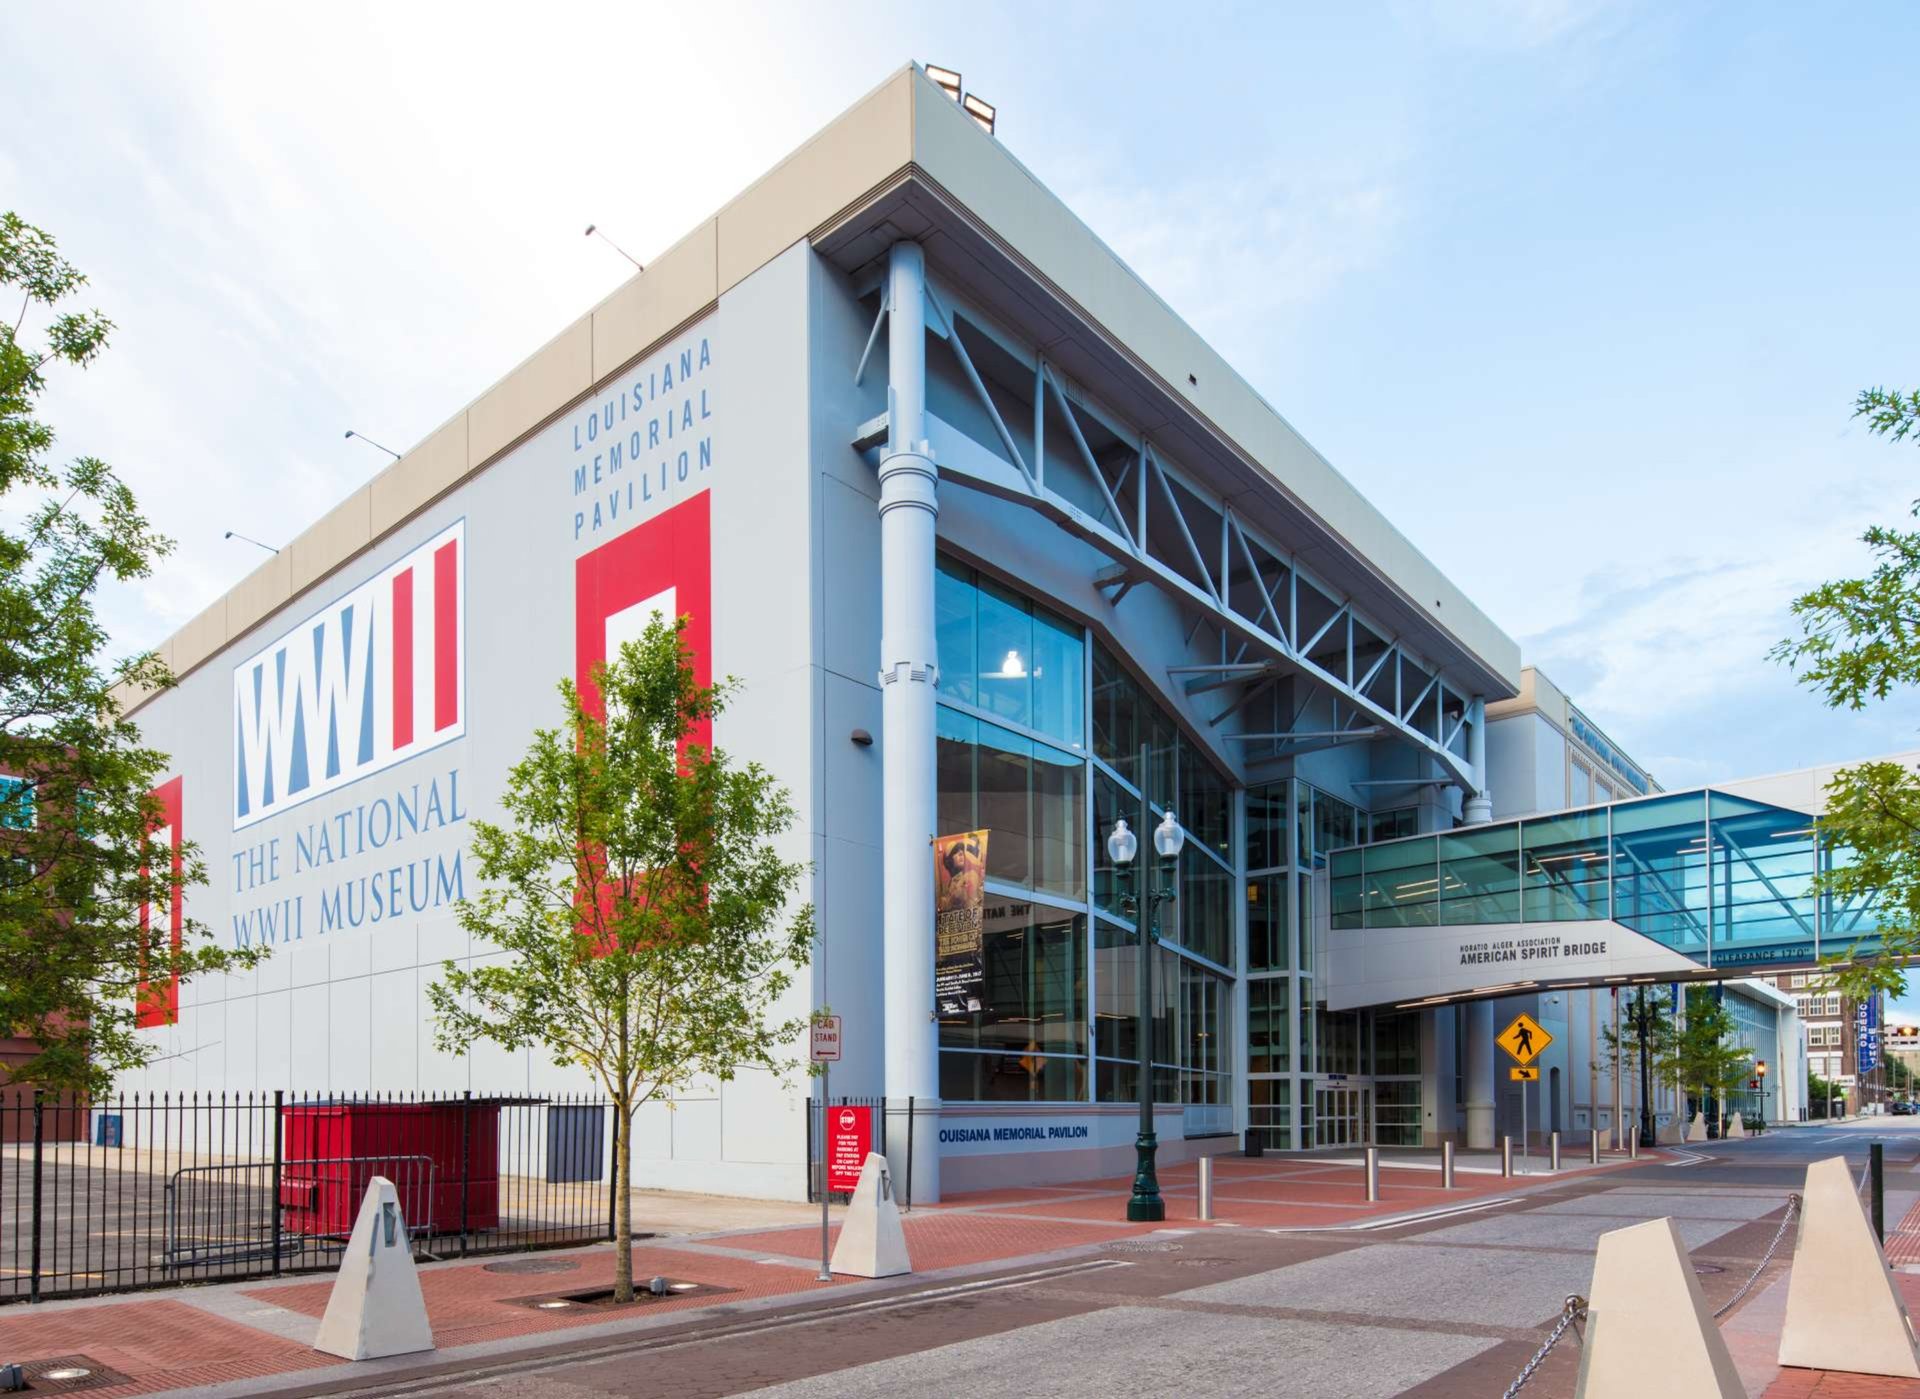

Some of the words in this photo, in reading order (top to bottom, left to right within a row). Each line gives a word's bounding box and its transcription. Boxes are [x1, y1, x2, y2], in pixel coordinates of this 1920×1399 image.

[574, 338, 711, 452] LOUISIANA
[574, 389, 711, 496] MEMORIAL
[575, 437, 711, 540] PAVILION
[237, 538, 457, 818] WWII
[232, 838, 279, 893] THE
[295, 769, 466, 873] NATIONAL
[232, 896, 303, 950] WWII
[319, 848, 465, 934] MUSEUM
[1460, 943, 1488, 952] HORATIO
[1492, 940, 1513, 949] ALGER
[1517, 936, 1561, 947] ASSOCIATION
[1460, 949, 1517, 965] AMERICAN
[1521, 945, 1560, 960] SPIRIT
[1564, 941, 1607, 956] BRIDGE
[1716, 950, 1777, 964] CLEARANCE
[815, 1032, 837, 1043] STAND
[817, 1019, 834, 1029] CAB
[1859, 1003, 1868, 1048] ODWARD
[1868, 1027, 1877, 1064] WIGHT
[840, 1116, 855, 1124] STOP
[939, 1128, 991, 1143] OUISIANA
[993, 1126, 1046, 1141] MEMORIAL
[1048, 1125, 1088, 1139] PAVILION
